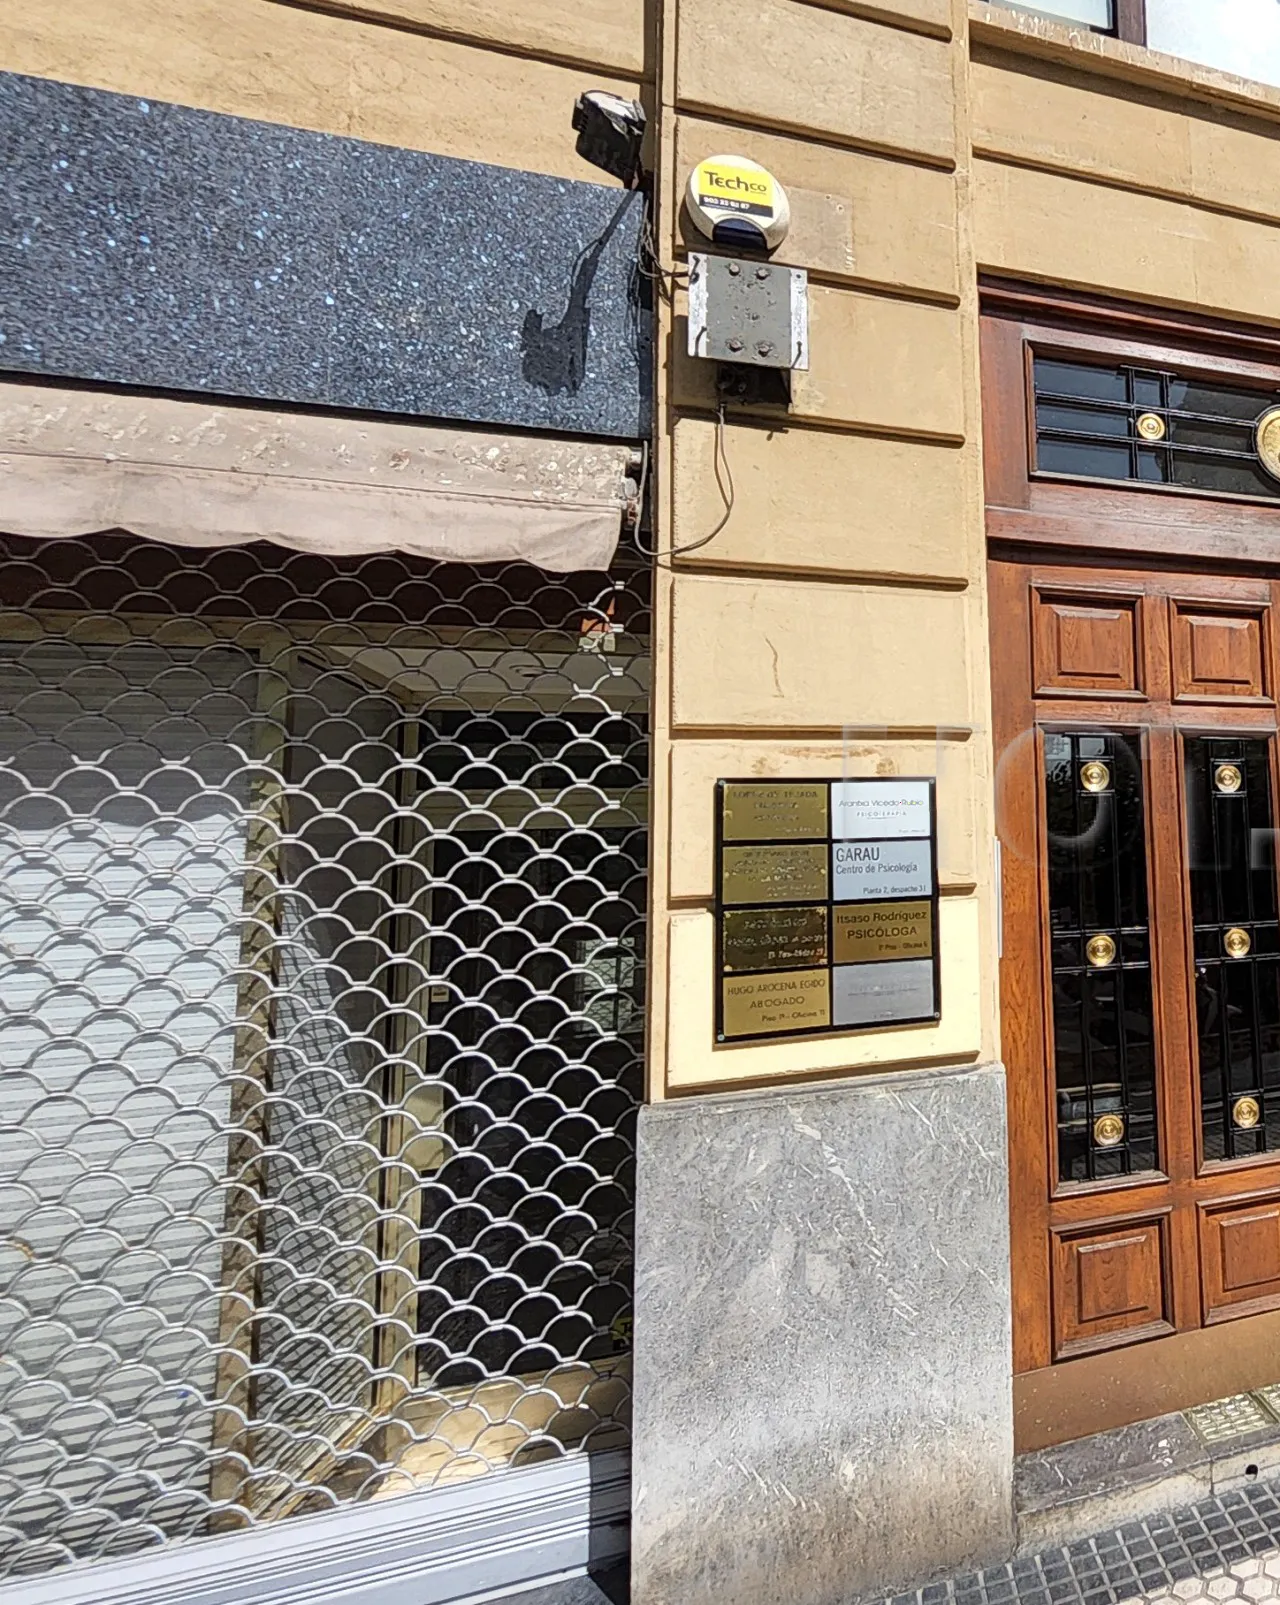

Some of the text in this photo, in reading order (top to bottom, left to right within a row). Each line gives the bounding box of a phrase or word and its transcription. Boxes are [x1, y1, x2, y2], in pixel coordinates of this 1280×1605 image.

[836, 846, 880, 863] GARAU
[836, 864, 864, 875] Centro
[865, 863, 876, 873] de
[836, 910, 928, 924] Itsaso Rodríguez
[847, 926, 918, 940] PSICÓLOGA
[727, 978, 826, 996] HUGO AROCENA EGIDO
[749, 995, 806, 1009] ABOGADO
